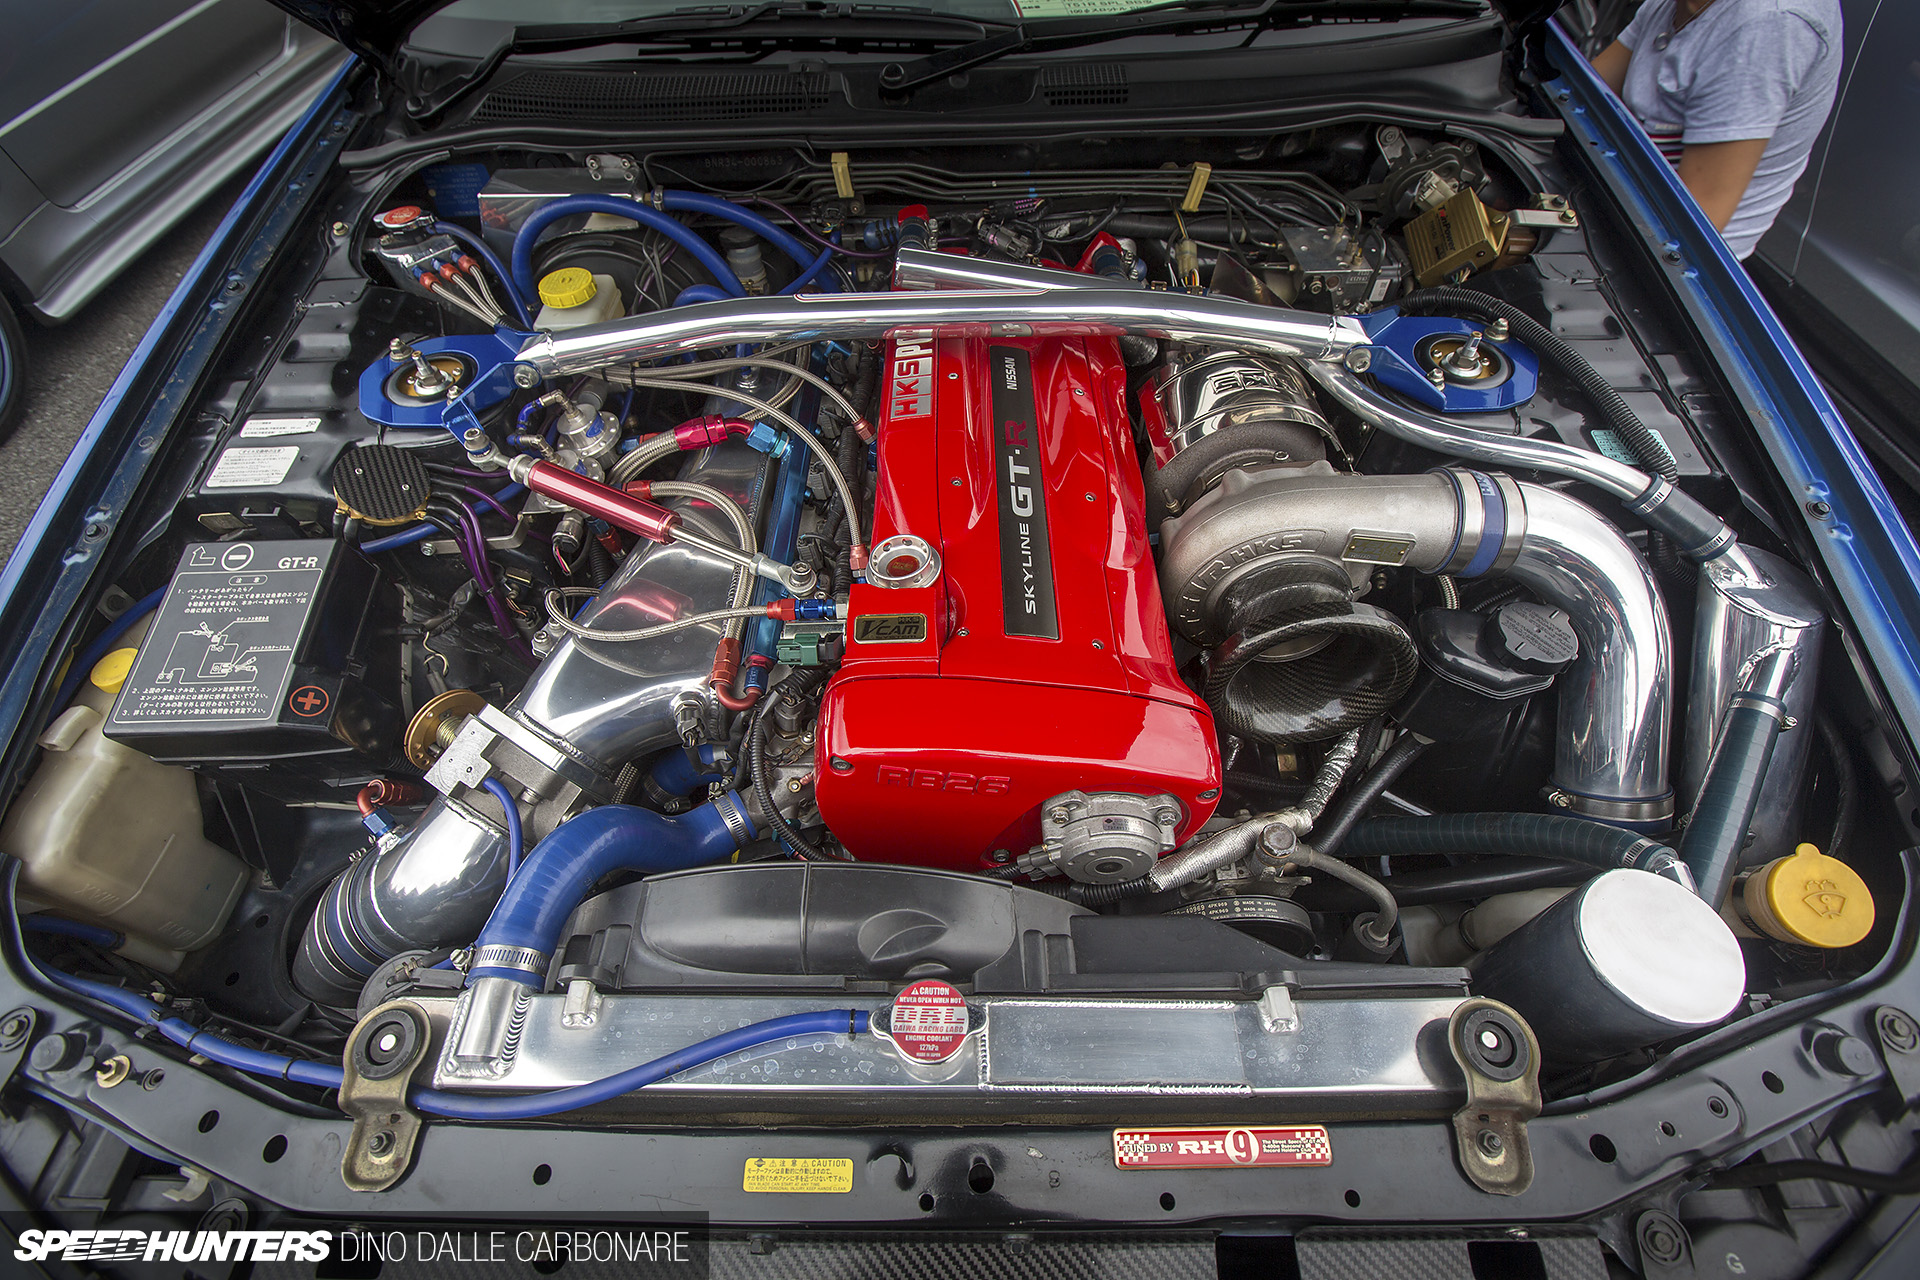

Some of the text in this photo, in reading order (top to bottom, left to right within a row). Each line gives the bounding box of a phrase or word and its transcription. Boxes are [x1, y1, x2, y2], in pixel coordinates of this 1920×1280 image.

[1006, 357, 1017, 390] NISSAN
[278, 556, 319, 570] GT-R
[1231, 533, 1303, 566] HKS
[1019, 522, 1036, 615] SKYLINE
[877, 765, 1010, 796] RB26
[920, 987, 950, 995] CAUTION
[1123, 1143, 1158, 1153] TUNED
[1160, 1143, 1174, 1154] BY
